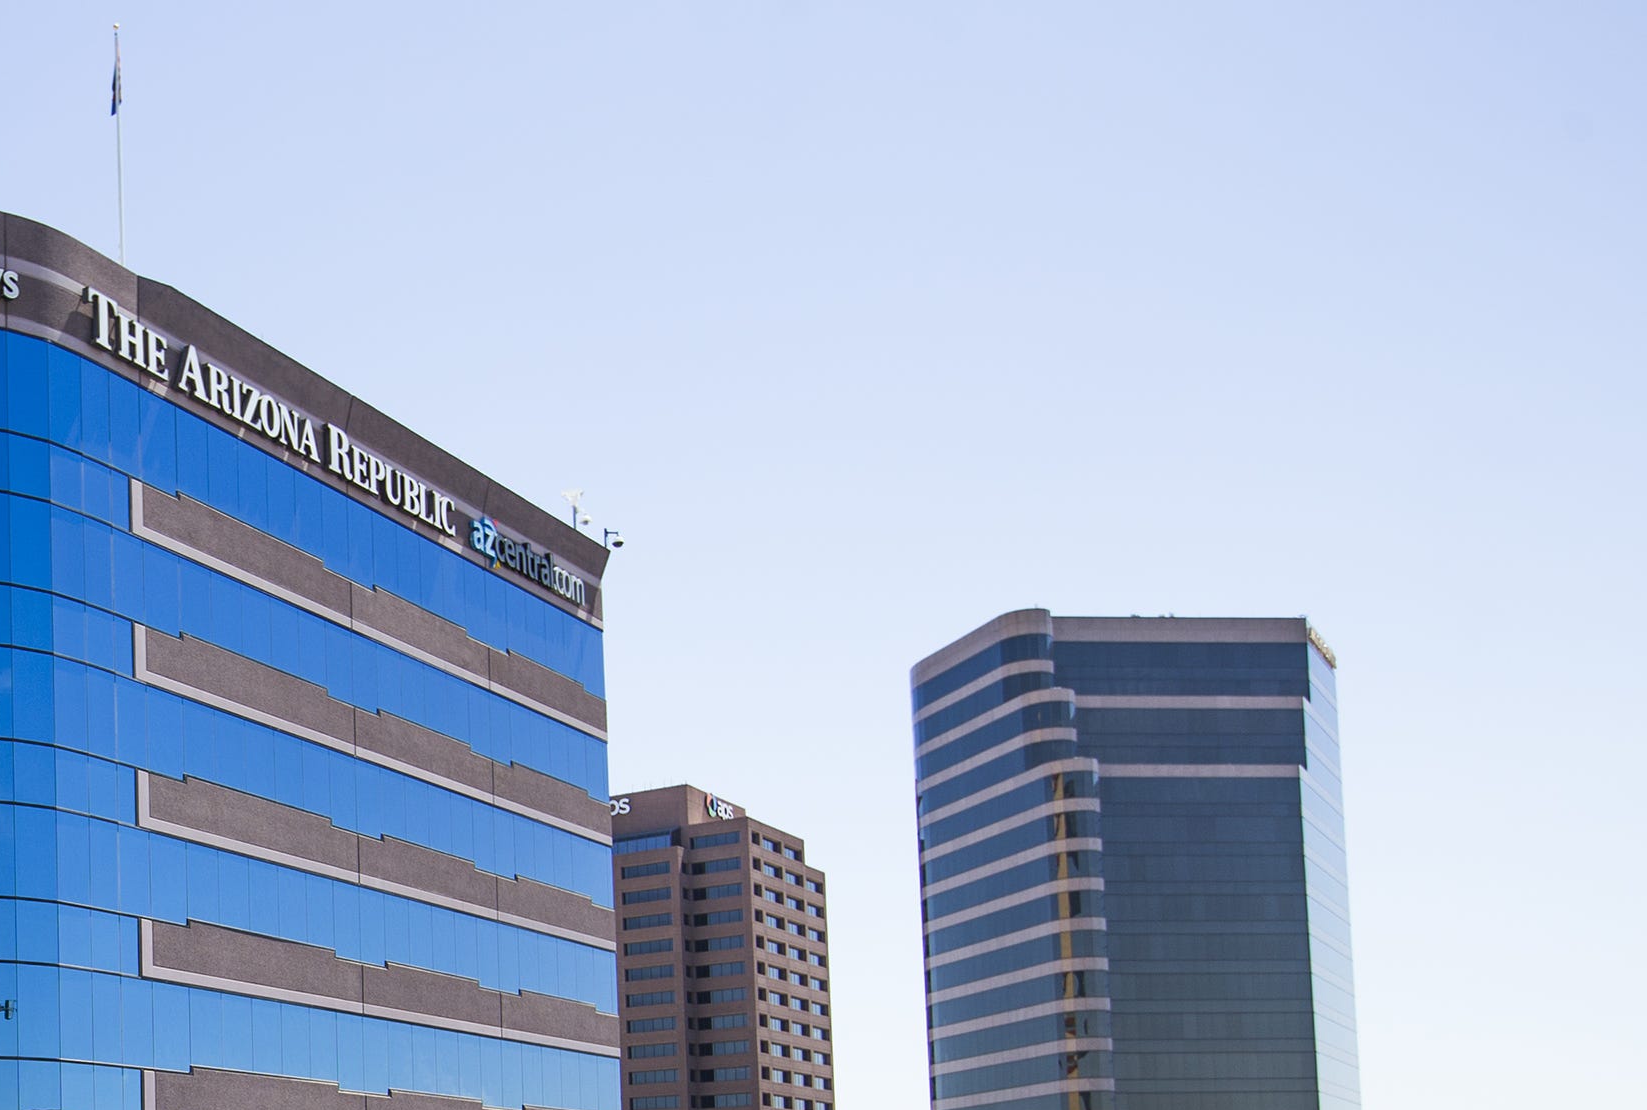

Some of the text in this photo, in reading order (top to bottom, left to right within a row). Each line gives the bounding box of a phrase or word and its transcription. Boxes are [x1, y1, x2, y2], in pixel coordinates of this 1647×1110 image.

[86, 286, 456, 536] THE ARIZONA REPUBLIC
[471, 517, 586, 606] azcentral.com
